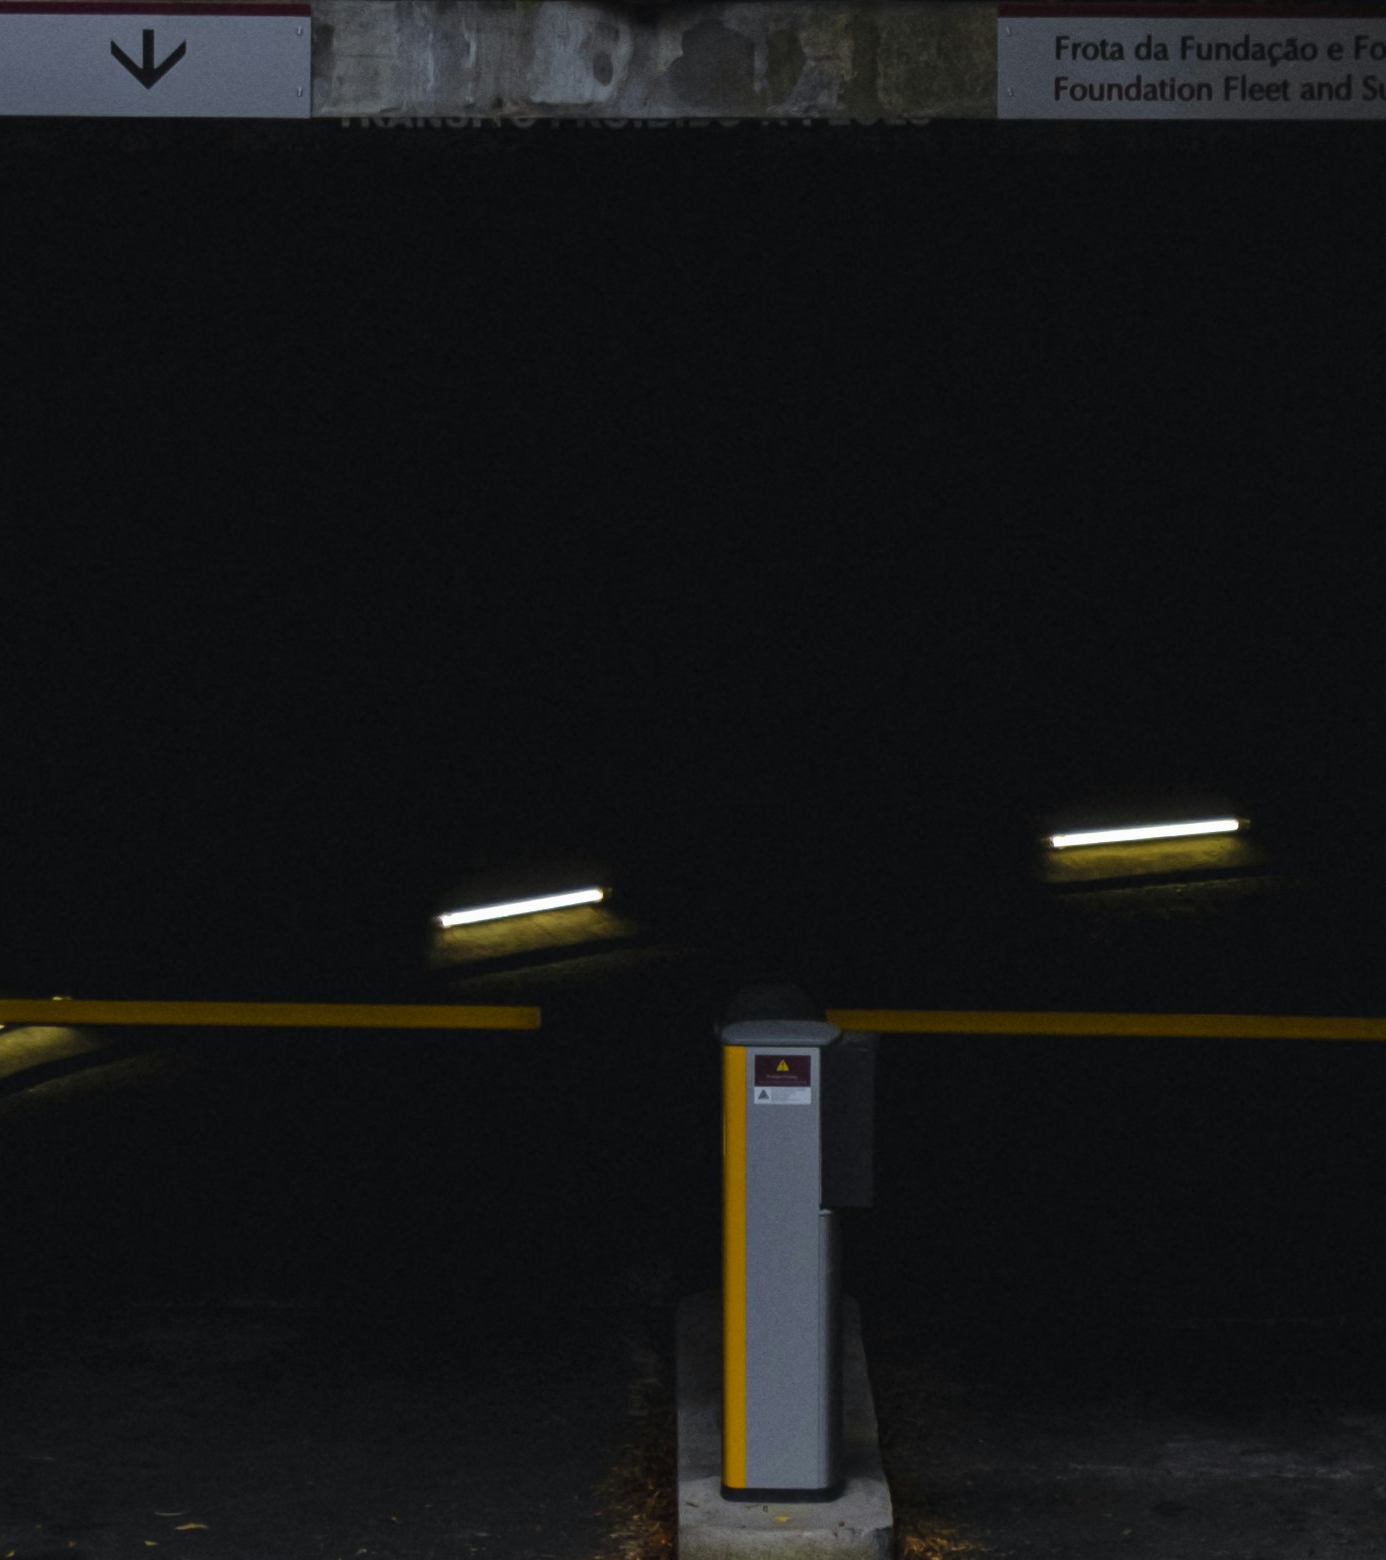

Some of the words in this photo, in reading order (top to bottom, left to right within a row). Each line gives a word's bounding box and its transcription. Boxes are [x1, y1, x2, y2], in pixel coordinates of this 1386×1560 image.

[1054, 34, 1125, 62] Frota
[1133, 33, 1170, 62] da
[1179, 33, 1319, 68] Fundação
[1326, 42, 1344, 62] e
[1053, 74, 1213, 102] Foundation
[1223, 74, 1291, 102] Fleet
[1299, 73, 1353, 102] and
